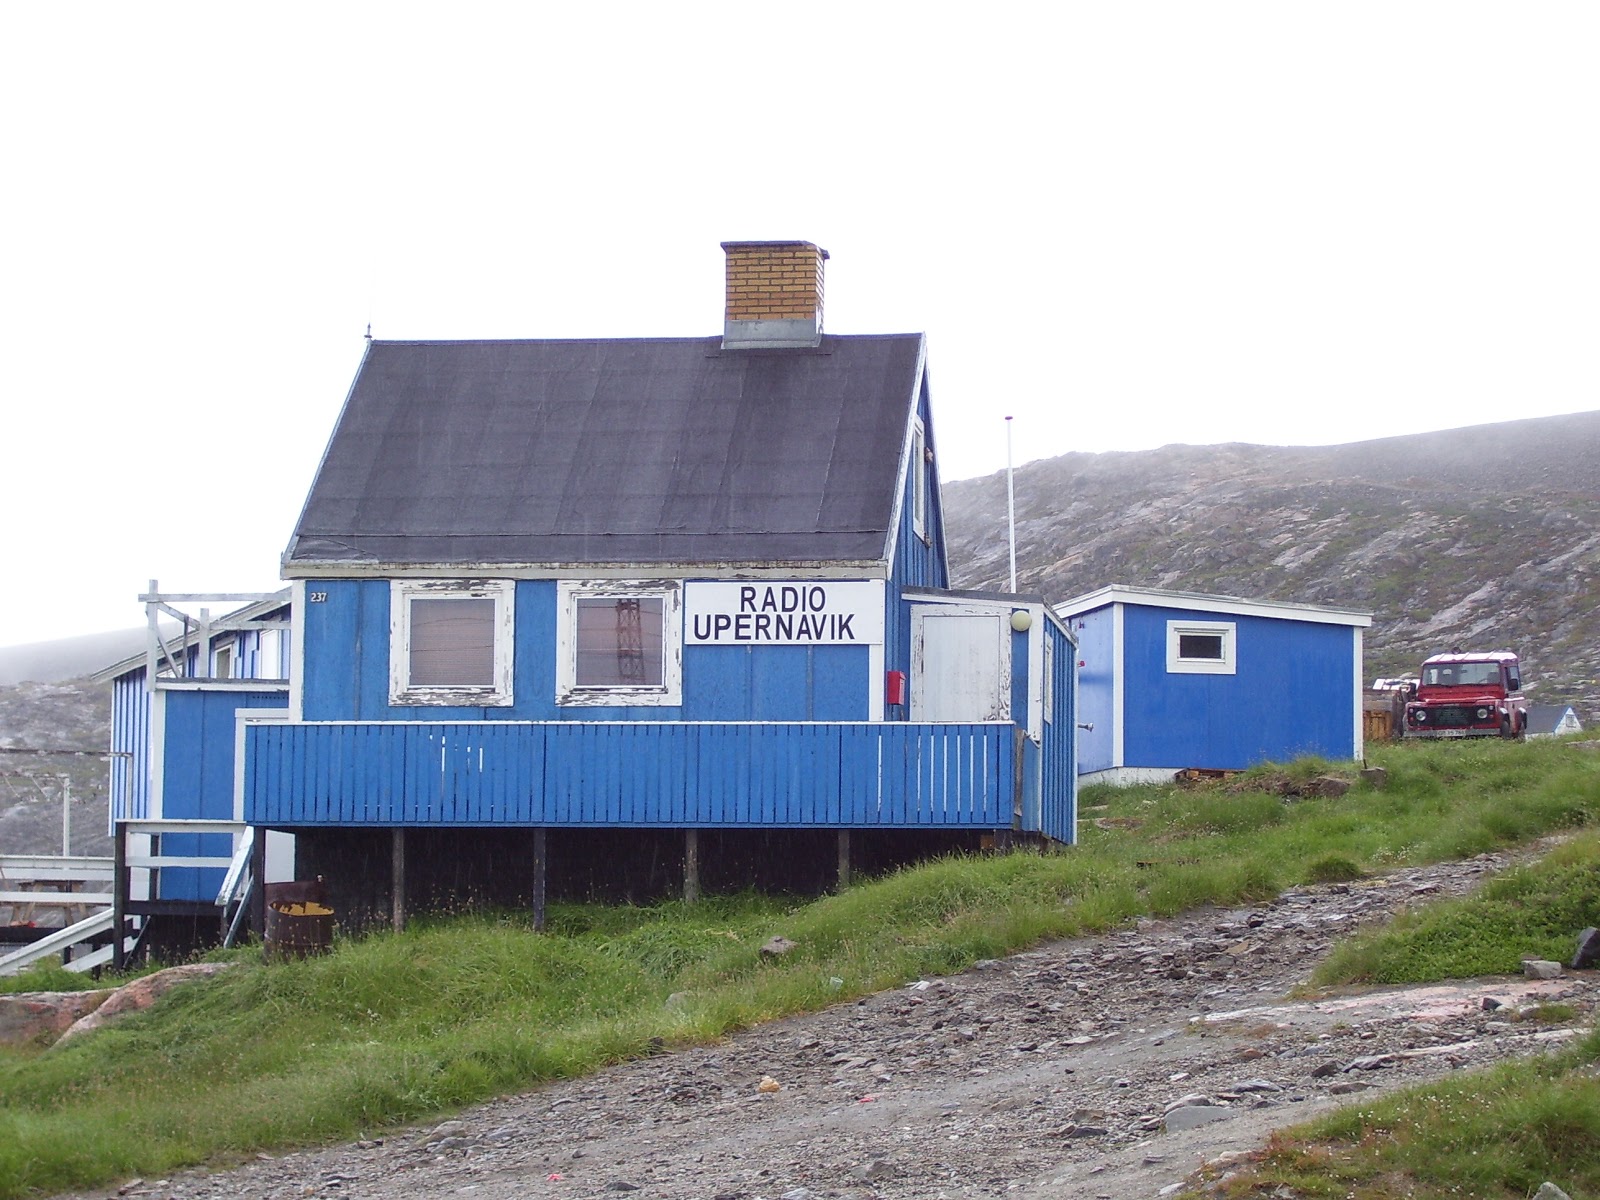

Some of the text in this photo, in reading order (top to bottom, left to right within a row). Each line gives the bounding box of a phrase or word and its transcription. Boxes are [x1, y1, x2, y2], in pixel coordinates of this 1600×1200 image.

[310, 592, 327, 602] 237
[740, 586, 826, 612] RADIO
[694, 613, 855, 640] UPERNAVIK
